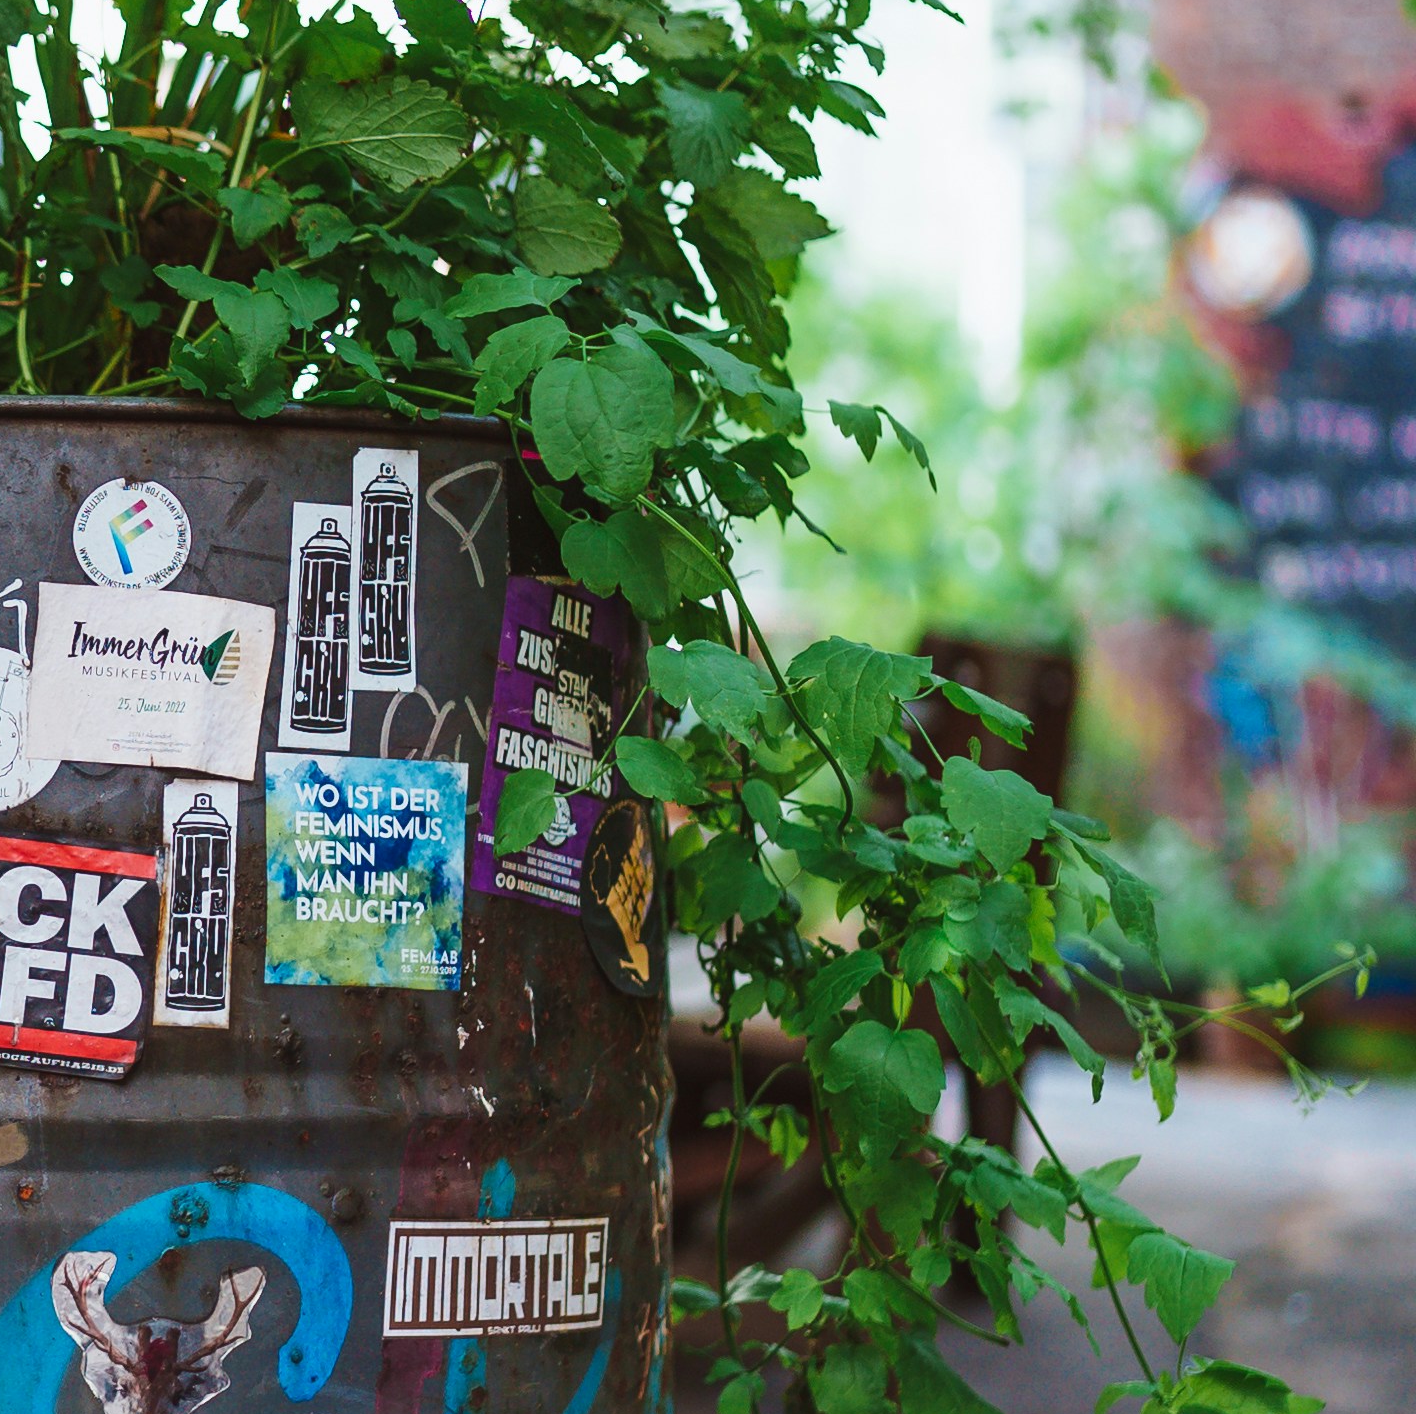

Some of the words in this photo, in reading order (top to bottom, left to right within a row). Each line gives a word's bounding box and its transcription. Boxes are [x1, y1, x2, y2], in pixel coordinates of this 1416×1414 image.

[551, 594, 591, 638] ALLE
[68, 621, 219, 669] ImmerGrün
[82, 666, 200, 683] MUSIKFESTIVAL
[136, 698, 161, 713] Juni
[165, 702, 186, 714] 2022
[295, 783, 340, 808] WO
[347, 785, 382, 810] IST
[391, 787, 440, 812] DER
[295, 811, 446, 844] FEMINISMUS,
[294, 840, 375, 866] WENN
[296, 869, 355, 894] MAN
[363, 871, 408, 896] IHN
[296, 897, 425, 925] BRAUCHT?
[401, 949, 458, 965] FEMLAB
[394, 1231, 602, 1323] IMMORTALE
[487, 1325, 516, 1335] SANKT
[518, 1324, 541, 1334] PAULI
